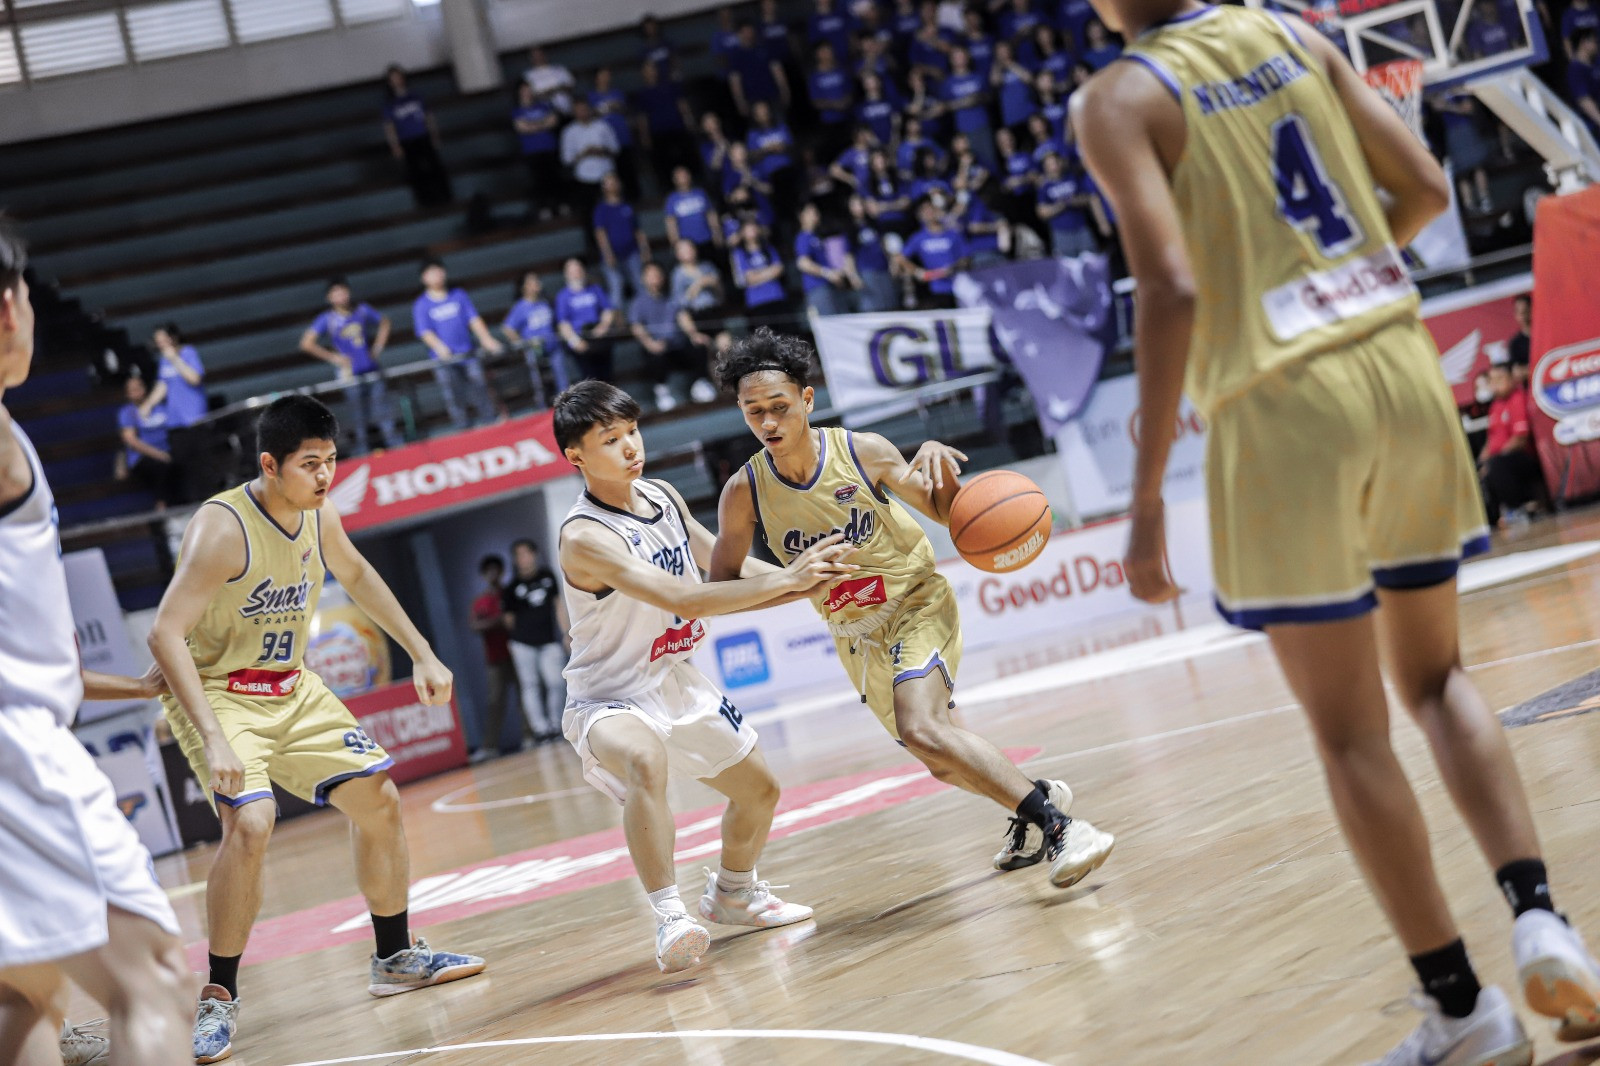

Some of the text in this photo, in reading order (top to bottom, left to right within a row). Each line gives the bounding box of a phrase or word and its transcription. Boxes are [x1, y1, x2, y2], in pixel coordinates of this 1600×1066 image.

[1272, 113, 1365, 259] 4
[371, 438, 557, 506] HONDA
[829, 591, 852, 610] EART
[258, 630, 295, 663] 99
[667, 637, 694, 651] HEART
[248, 682, 273, 693] HEART
